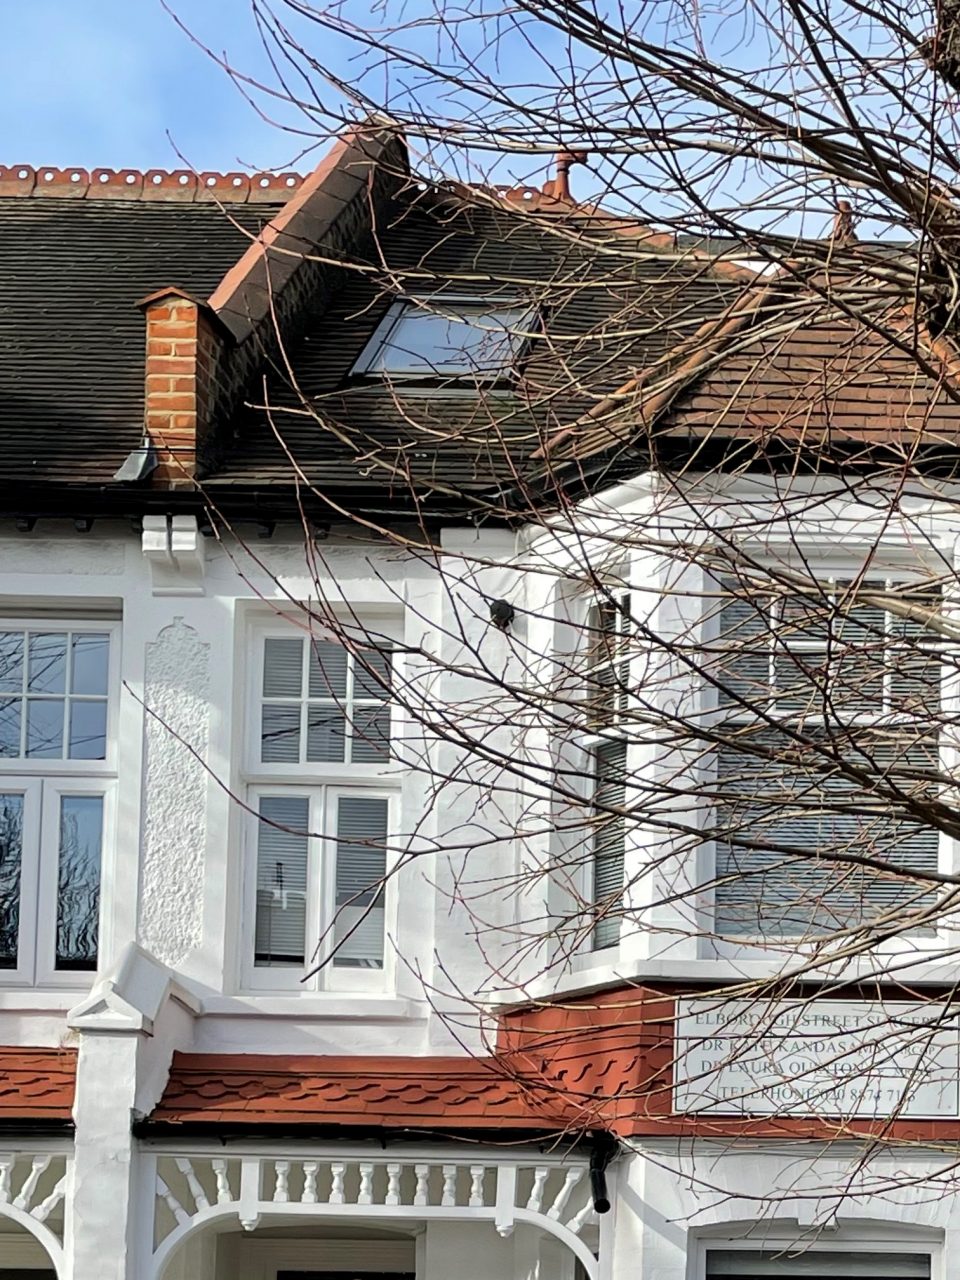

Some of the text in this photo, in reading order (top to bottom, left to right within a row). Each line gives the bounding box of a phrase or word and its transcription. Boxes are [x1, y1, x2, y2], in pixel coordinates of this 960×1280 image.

[802, 1015, 860, 1027] STREET
[702, 1040, 723, 1052] DR
[886, 1088, 916, 1101] 713
